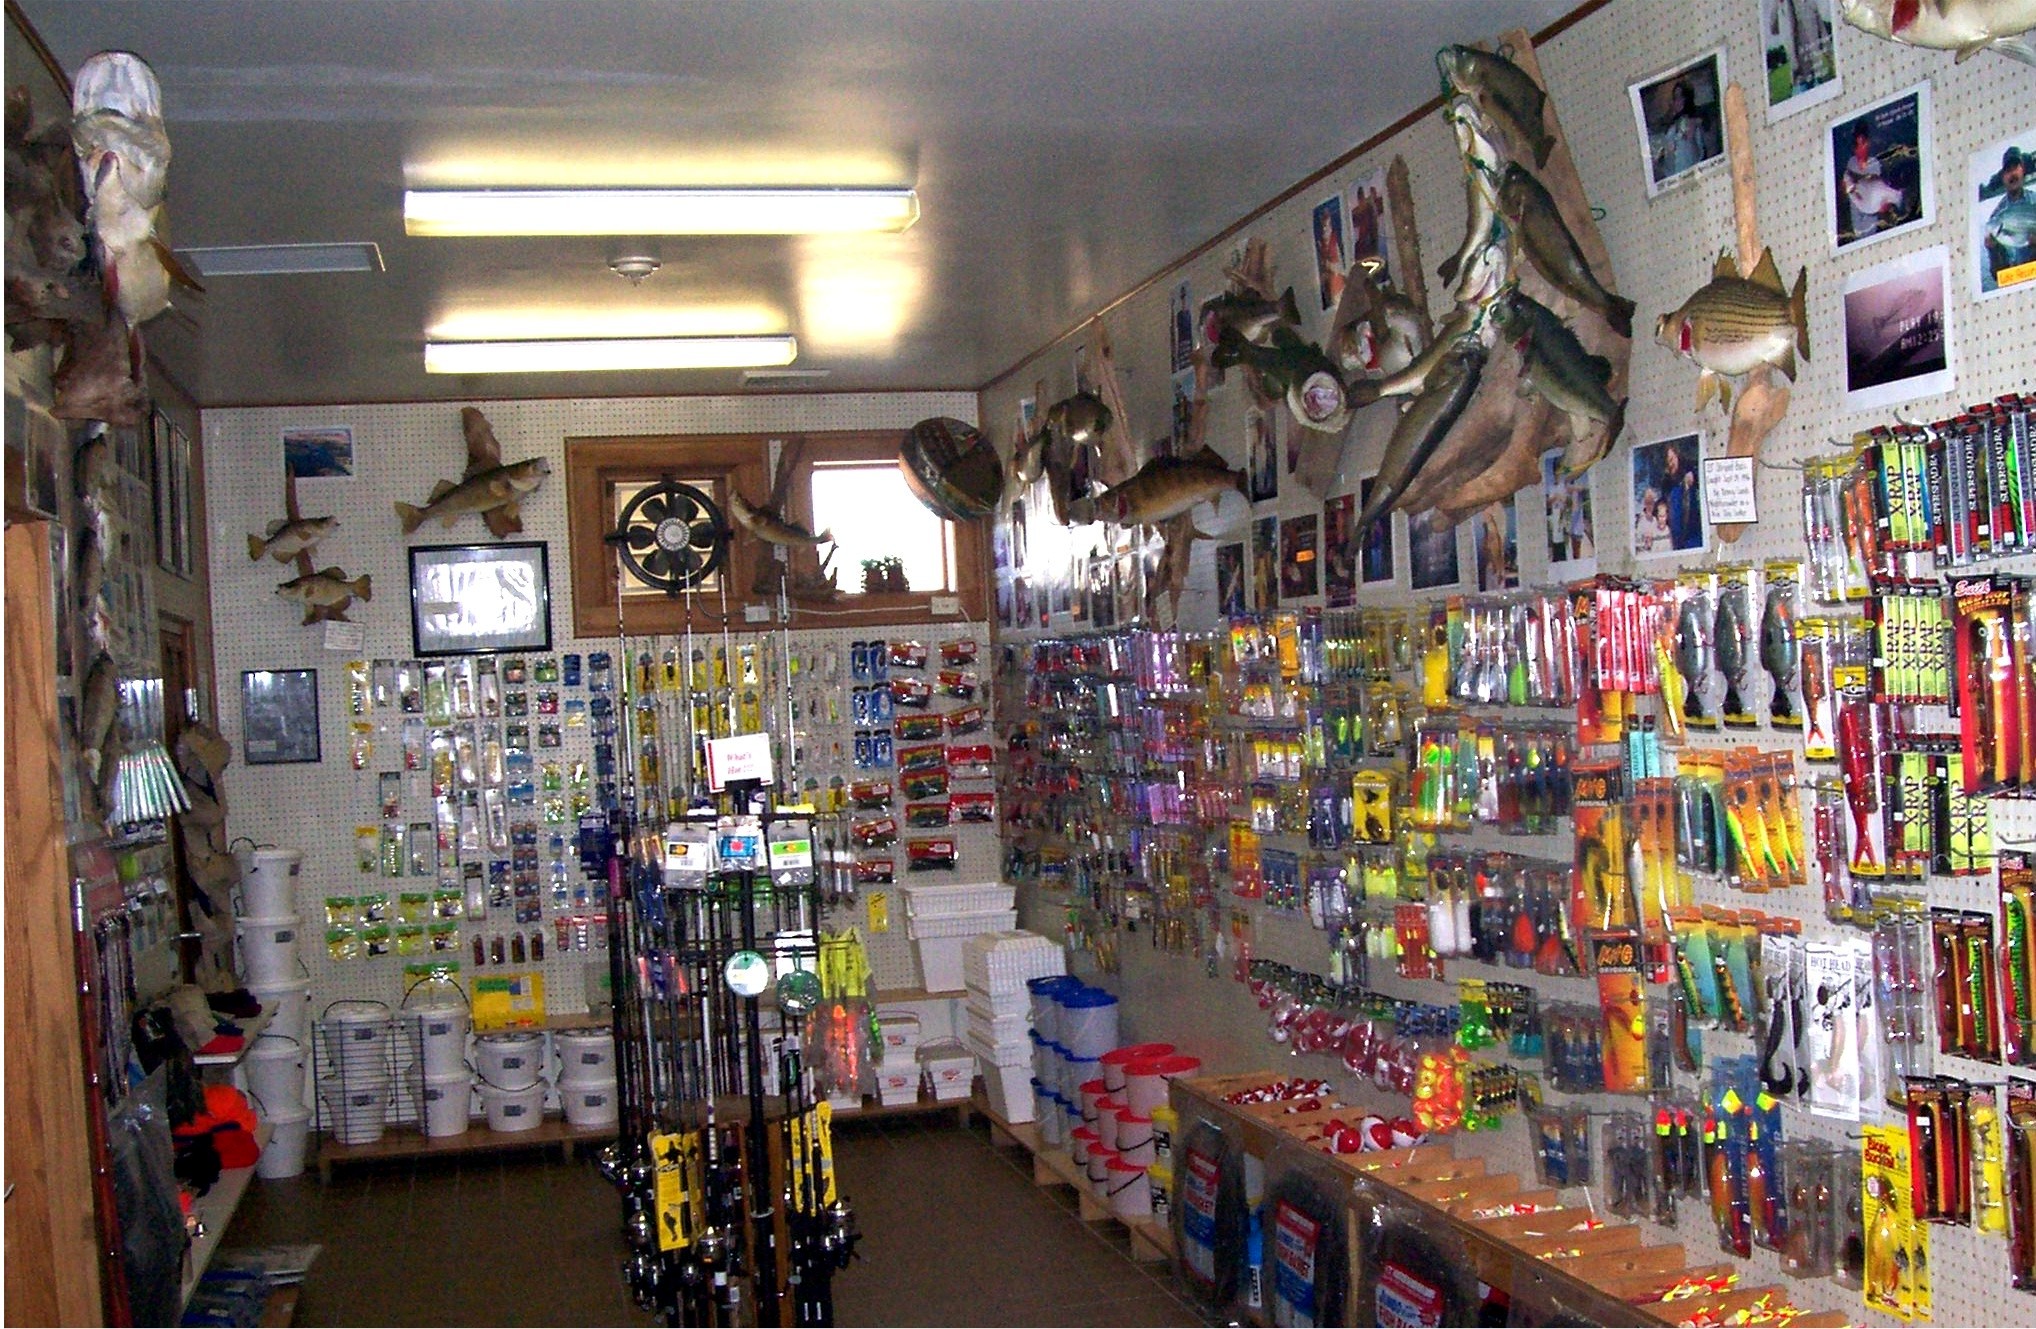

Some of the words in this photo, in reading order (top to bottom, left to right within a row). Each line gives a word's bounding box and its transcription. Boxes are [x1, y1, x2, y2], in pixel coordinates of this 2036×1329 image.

[1887, 465, 1904, 516] X-RAP
[1887, 618, 1900, 670] X-RAP
[1902, 619, 1917, 670] X-RAP
[1919, 619, 1934, 670] X-RAP
[1904, 775, 1920, 827] X-RAP
[1972, 799, 1989, 836] X-RA
